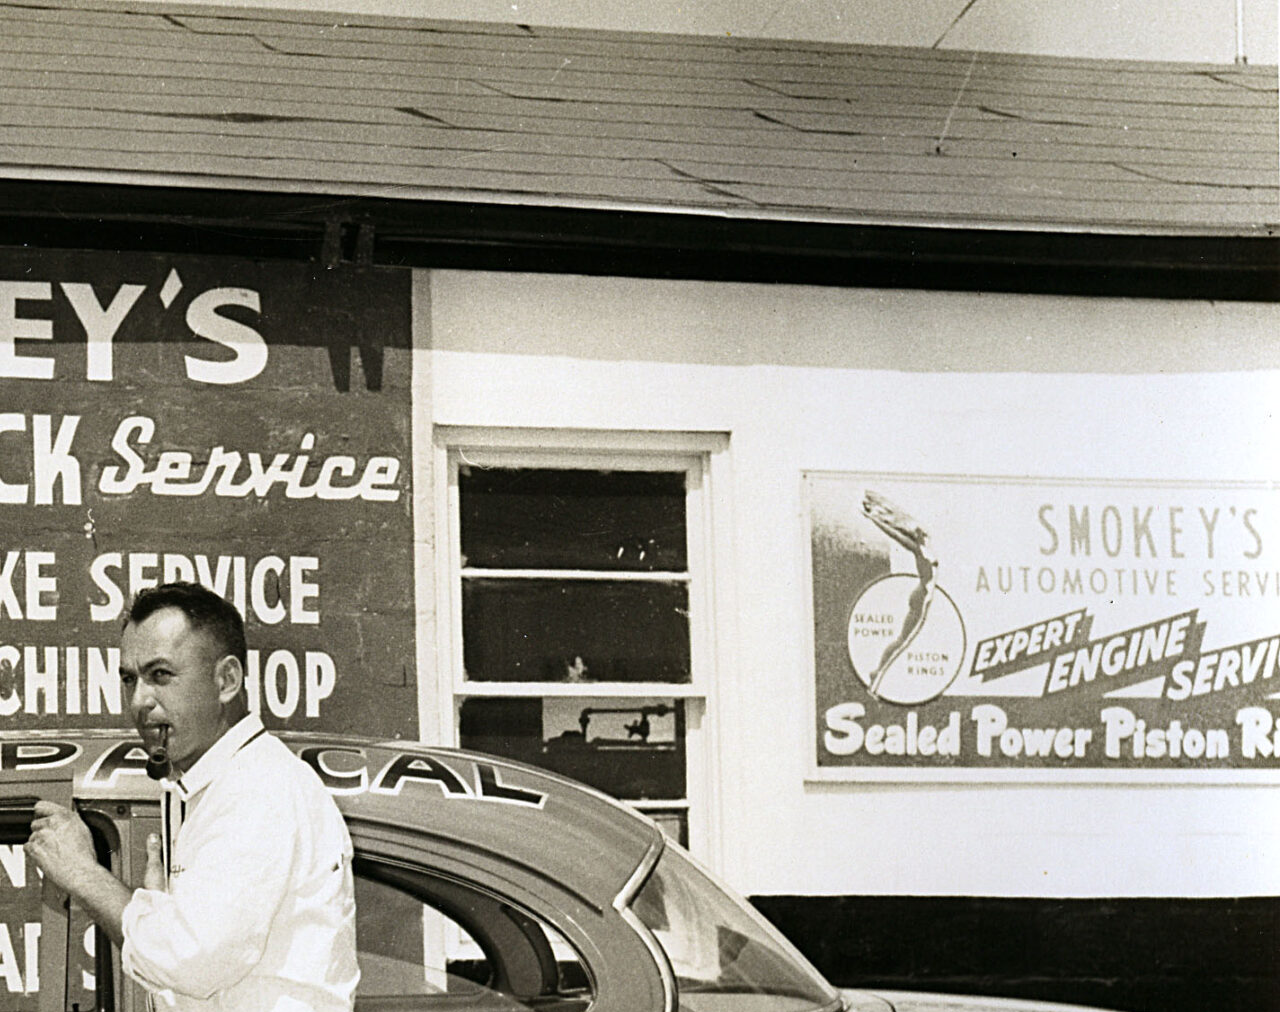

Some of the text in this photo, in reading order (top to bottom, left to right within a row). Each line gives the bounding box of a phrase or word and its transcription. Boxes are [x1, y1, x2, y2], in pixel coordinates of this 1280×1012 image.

[98, 416, 401, 503] Service
[1038, 504, 1263, 559] SMOKEY'S
[975, 566, 1177, 596] AUTOMOTIVE
[854, 614, 894, 637] SEALED POWER
[975, 611, 1086, 672] EXPERT
[1048, 615, 1192, 693] ENGINE
[907, 652, 949, 676] PISTON RINGS
[1166, 638, 1280, 701] SERVI
[824, 702, 961, 756] Sealed
[971, 704, 1092, 758] Power
[1101, 706, 1229, 759] Piston
